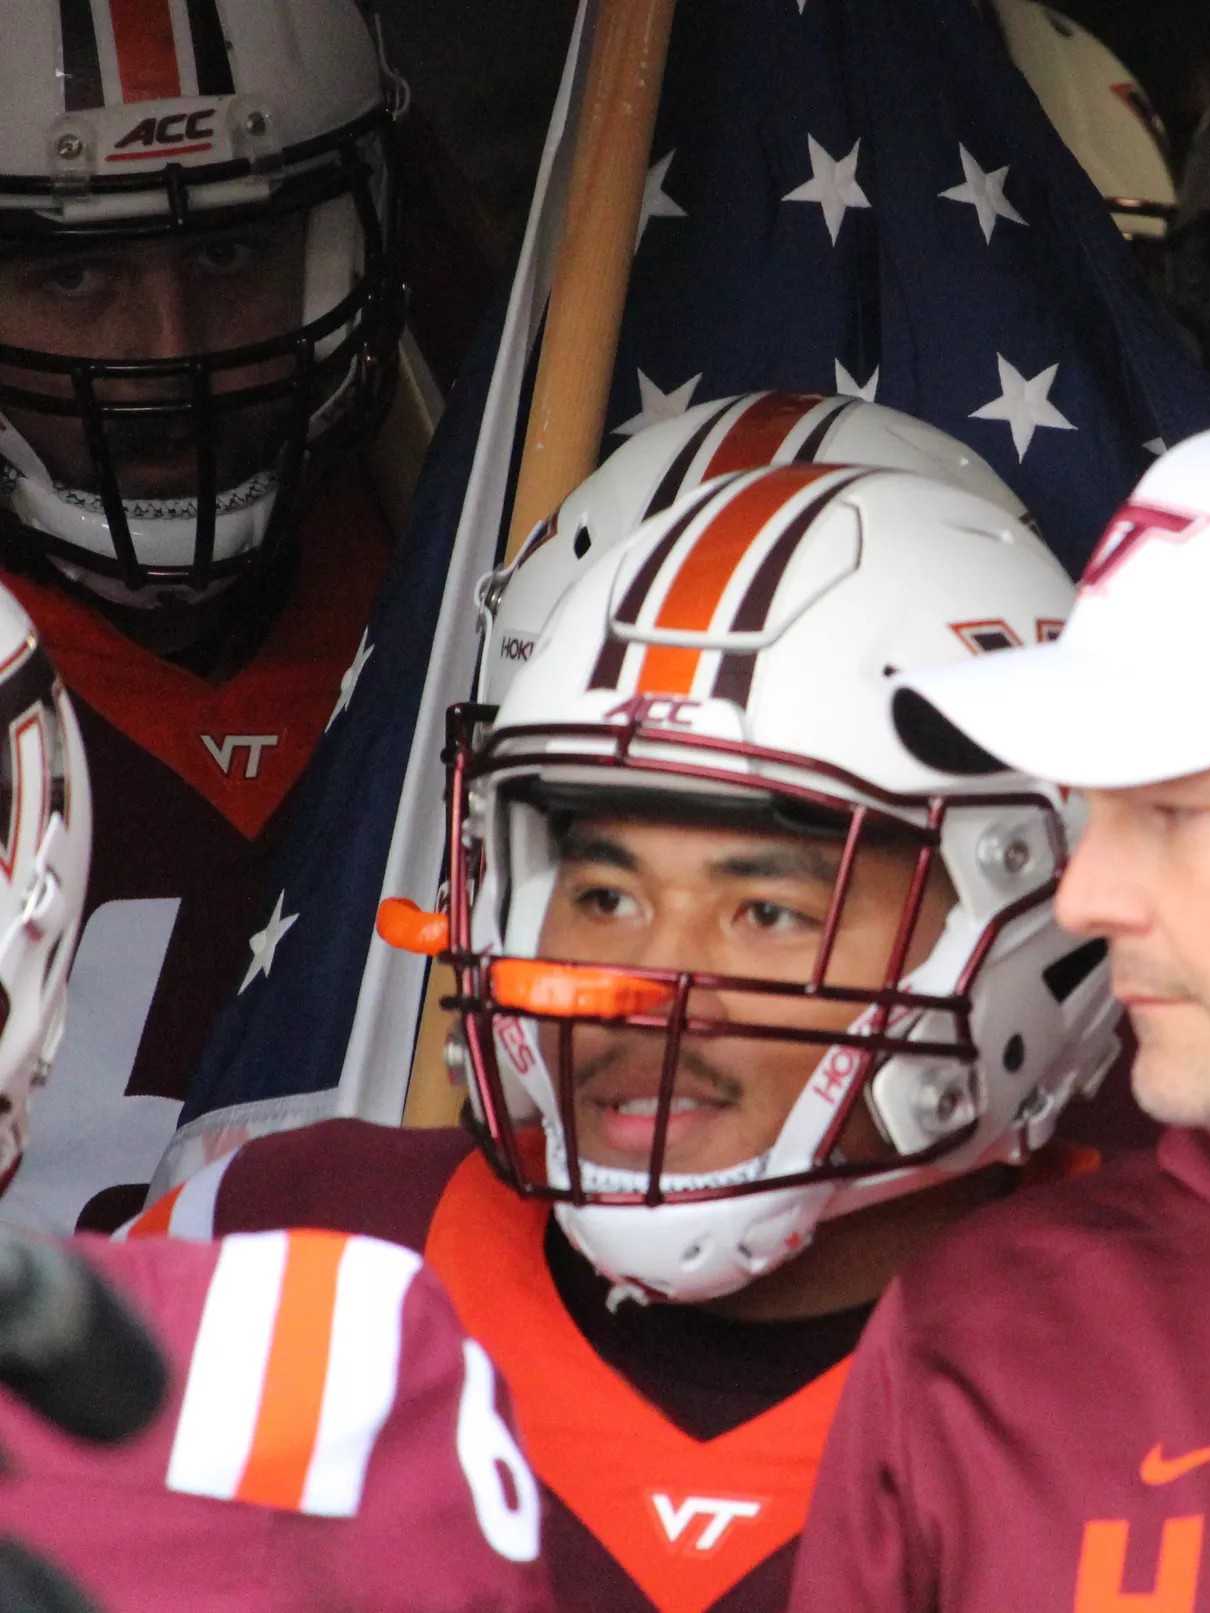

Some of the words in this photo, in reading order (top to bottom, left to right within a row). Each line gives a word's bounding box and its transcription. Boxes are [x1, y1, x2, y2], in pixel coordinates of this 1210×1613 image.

[114, 108, 216, 149] ACC
[604, 695, 701, 725] ACC
[200, 734, 279, 778] VT
[652, 1494, 761, 1550] VT
